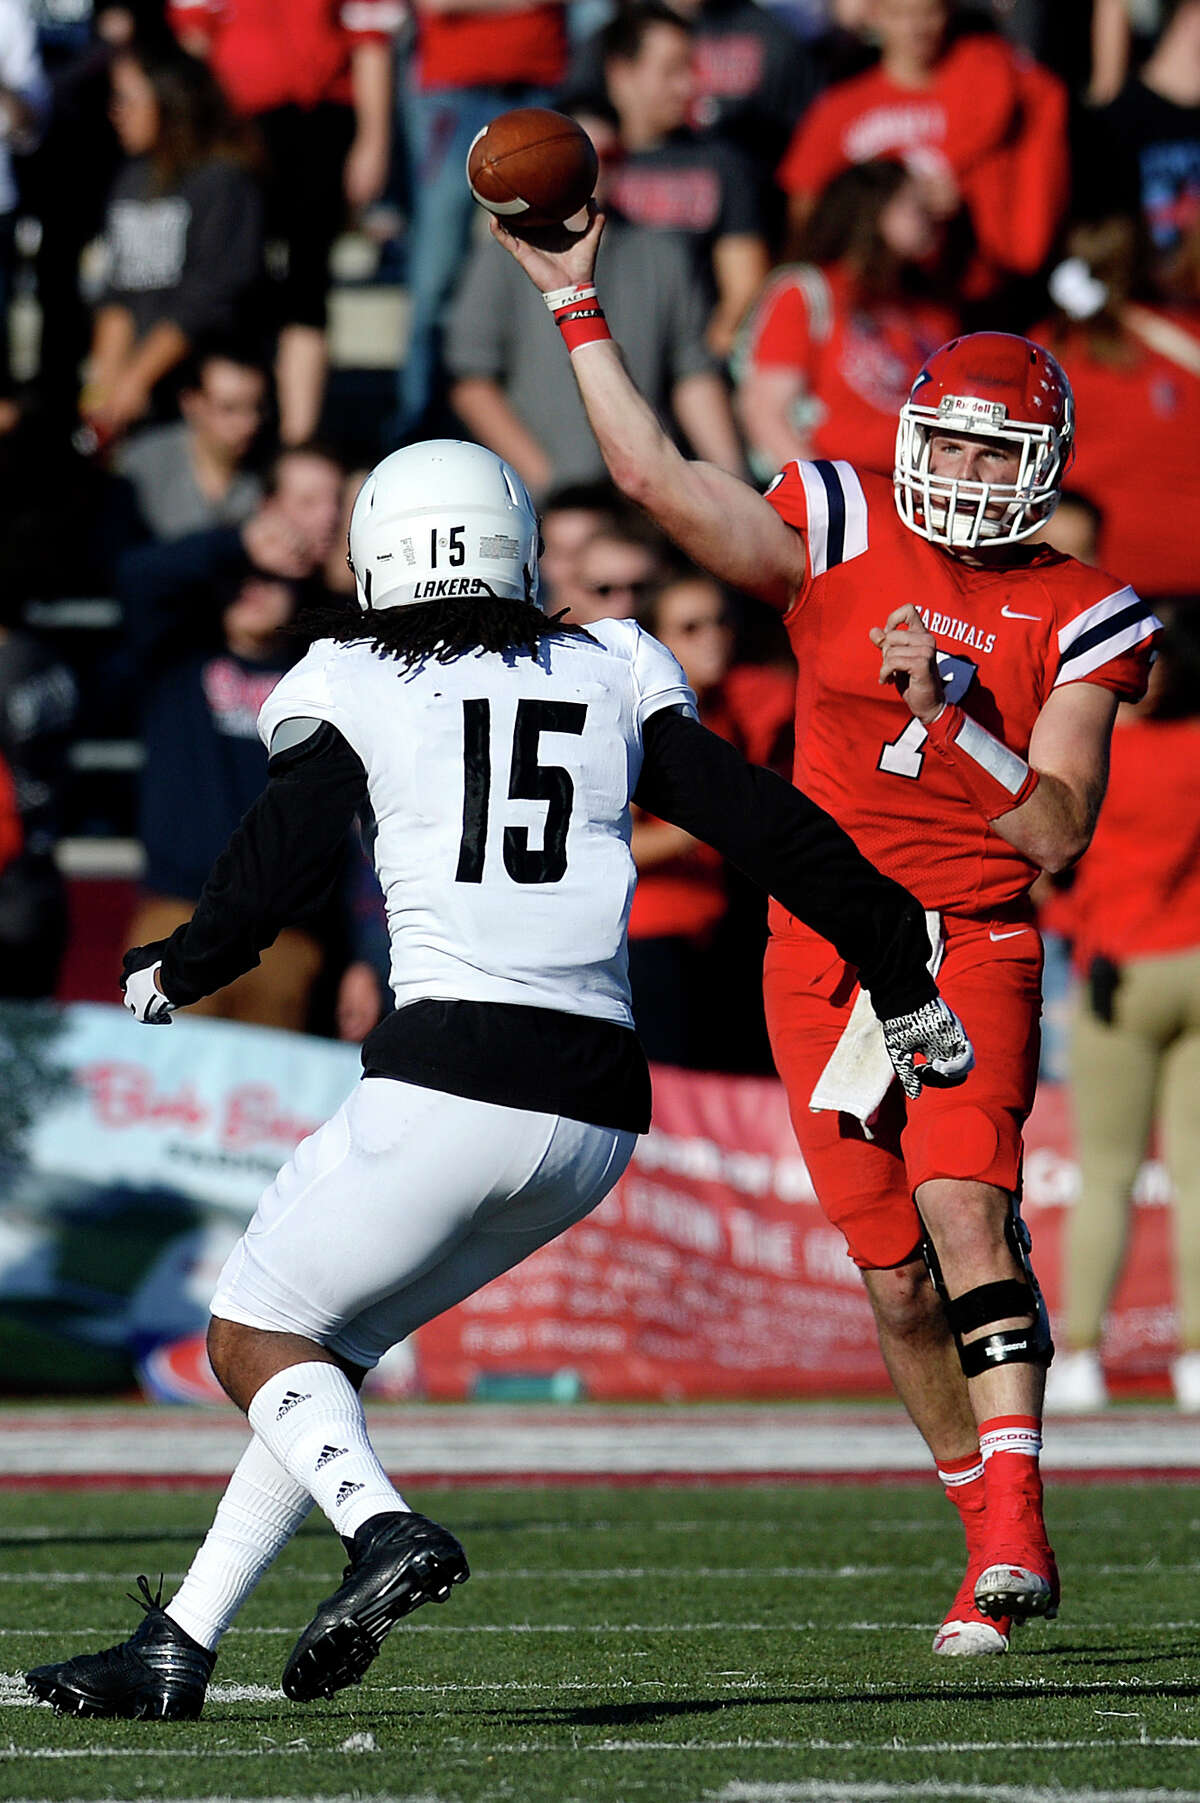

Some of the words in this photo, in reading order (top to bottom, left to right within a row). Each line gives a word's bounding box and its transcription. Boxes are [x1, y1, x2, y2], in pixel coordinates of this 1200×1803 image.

[955, 399, 992, 413] Ridell
[430, 525, 466, 569] 15
[413, 578, 483, 599] LAKERS
[875, 648, 979, 782] 7
[454, 697, 590, 885] 15
[275, 1393, 312, 1421] adidas
[314, 1447, 350, 1472] adidas
[335, 1482, 366, 1508] adidas
